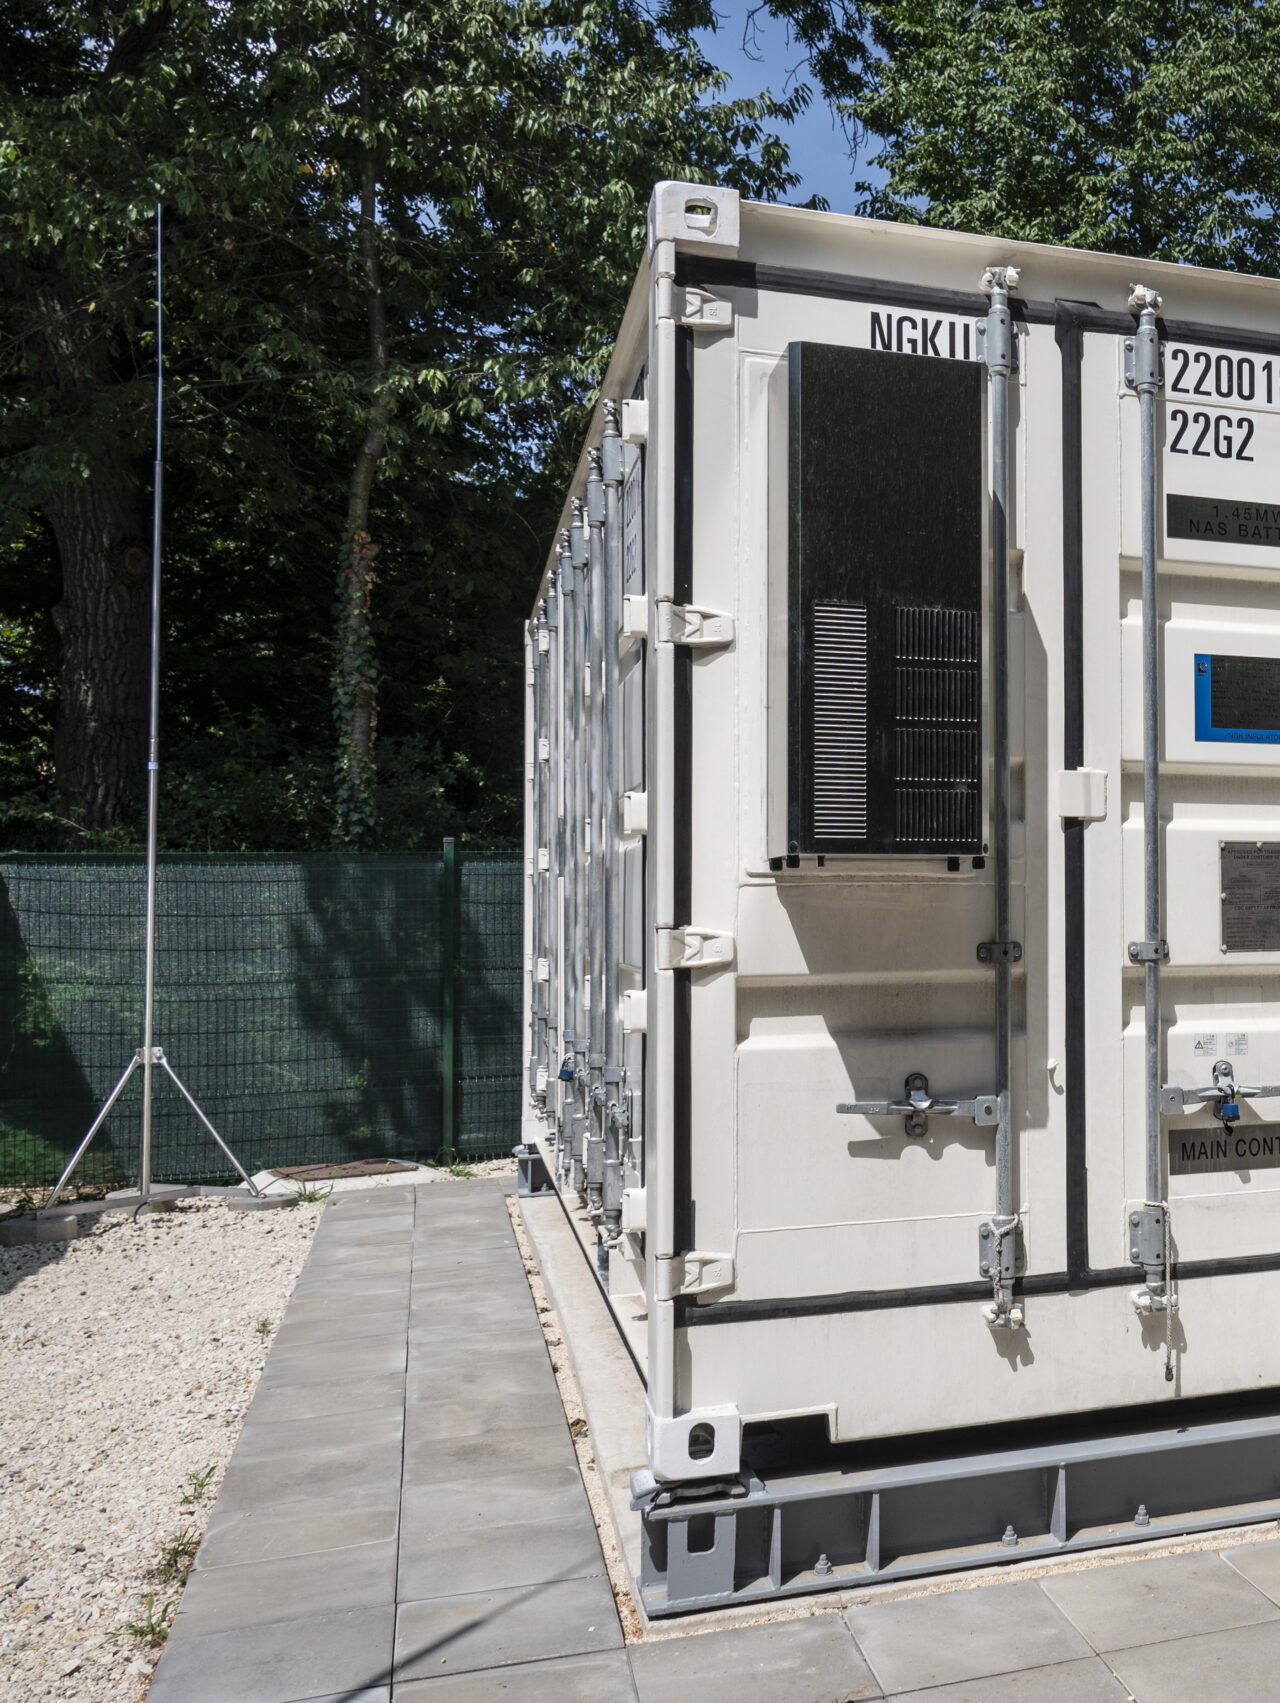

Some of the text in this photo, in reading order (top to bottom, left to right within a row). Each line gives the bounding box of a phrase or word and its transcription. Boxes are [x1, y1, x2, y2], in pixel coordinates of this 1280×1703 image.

[1169, 409, 1255, 462] 22G2
[1189, 519, 1228, 536] NAS
[1181, 1140, 1228, 1161] MAIN
